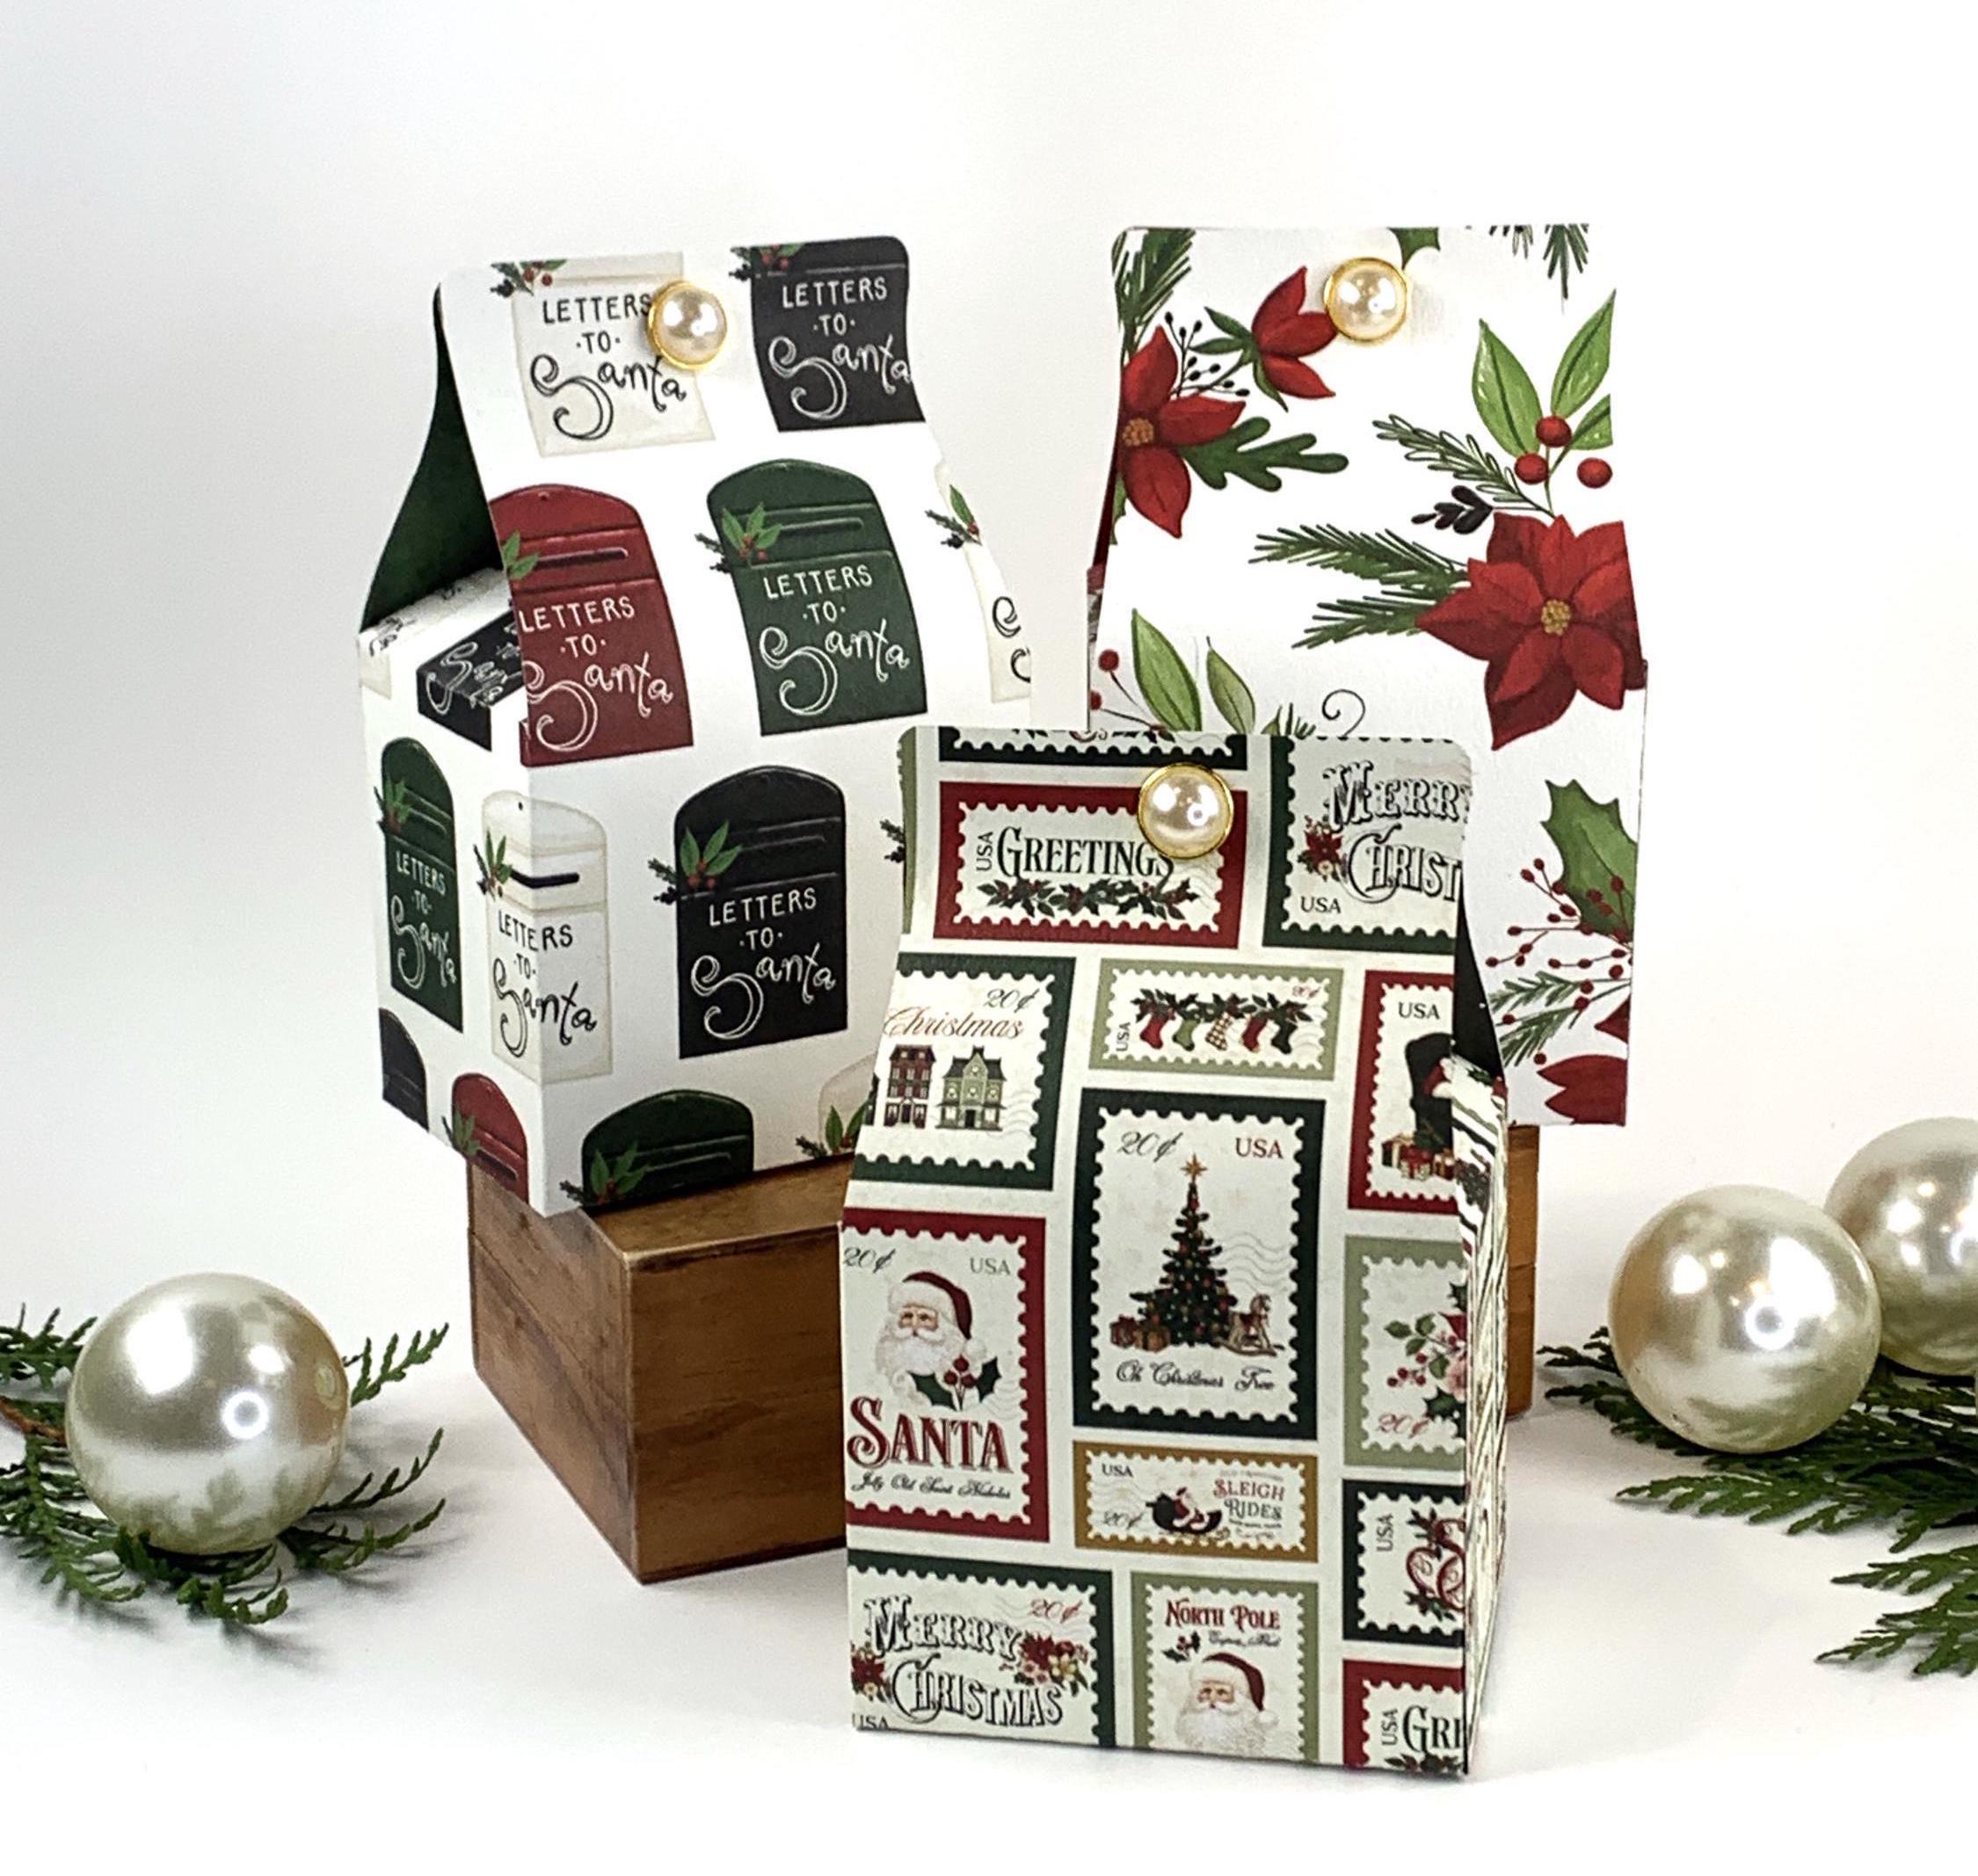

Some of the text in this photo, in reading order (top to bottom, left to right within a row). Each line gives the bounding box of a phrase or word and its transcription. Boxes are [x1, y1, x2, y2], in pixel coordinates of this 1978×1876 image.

[542, 293, 651, 324] LETTERS
[782, 276, 887, 309] LETTERS
[768, 334, 912, 419] Santa
[530, 353, 687, 440] Santa
[763, 564, 872, 600] LETTERS
[519, 595, 636, 633] LETTERS
[759, 619, 910, 716] Santa
[520, 651, 673, 752] Santa
[975, 831, 993, 872] USA
[997, 825, 1174, 884] GREETINGS
[396, 849, 446, 896] LETTERS
[709, 887, 817, 927] LETTERS
[1300, 897, 1342, 913] USA
[390, 894, 457, 990] Santa
[498, 910, 573, 952] LETTERS
[492, 957, 598, 1058] Santa
[691, 942, 836, 1040] Santa
[1398, 1001, 1441, 1020] USA
[883, 1006, 1024, 1039] Christmas
[1116, 1022, 1131, 1051] USA
[1234, 1138, 1284, 1160] USA
[970, 1258, 1011, 1276] USA
[847, 1395, 1014, 1475] SANTA
[1102, 1463, 1133, 1478] USA
[1212, 1477, 1285, 1502] SLEIGH
[1224, 1497, 1283, 1521] RIDES
[1377, 1513, 1394, 1552] USA
[863, 1595, 1022, 1662] MERRY
[1165, 1596, 1281, 1632] NORTH POLE
[888, 1653, 1064, 1727] CHRISTMAS
[1381, 1707, 1398, 1746] USA
